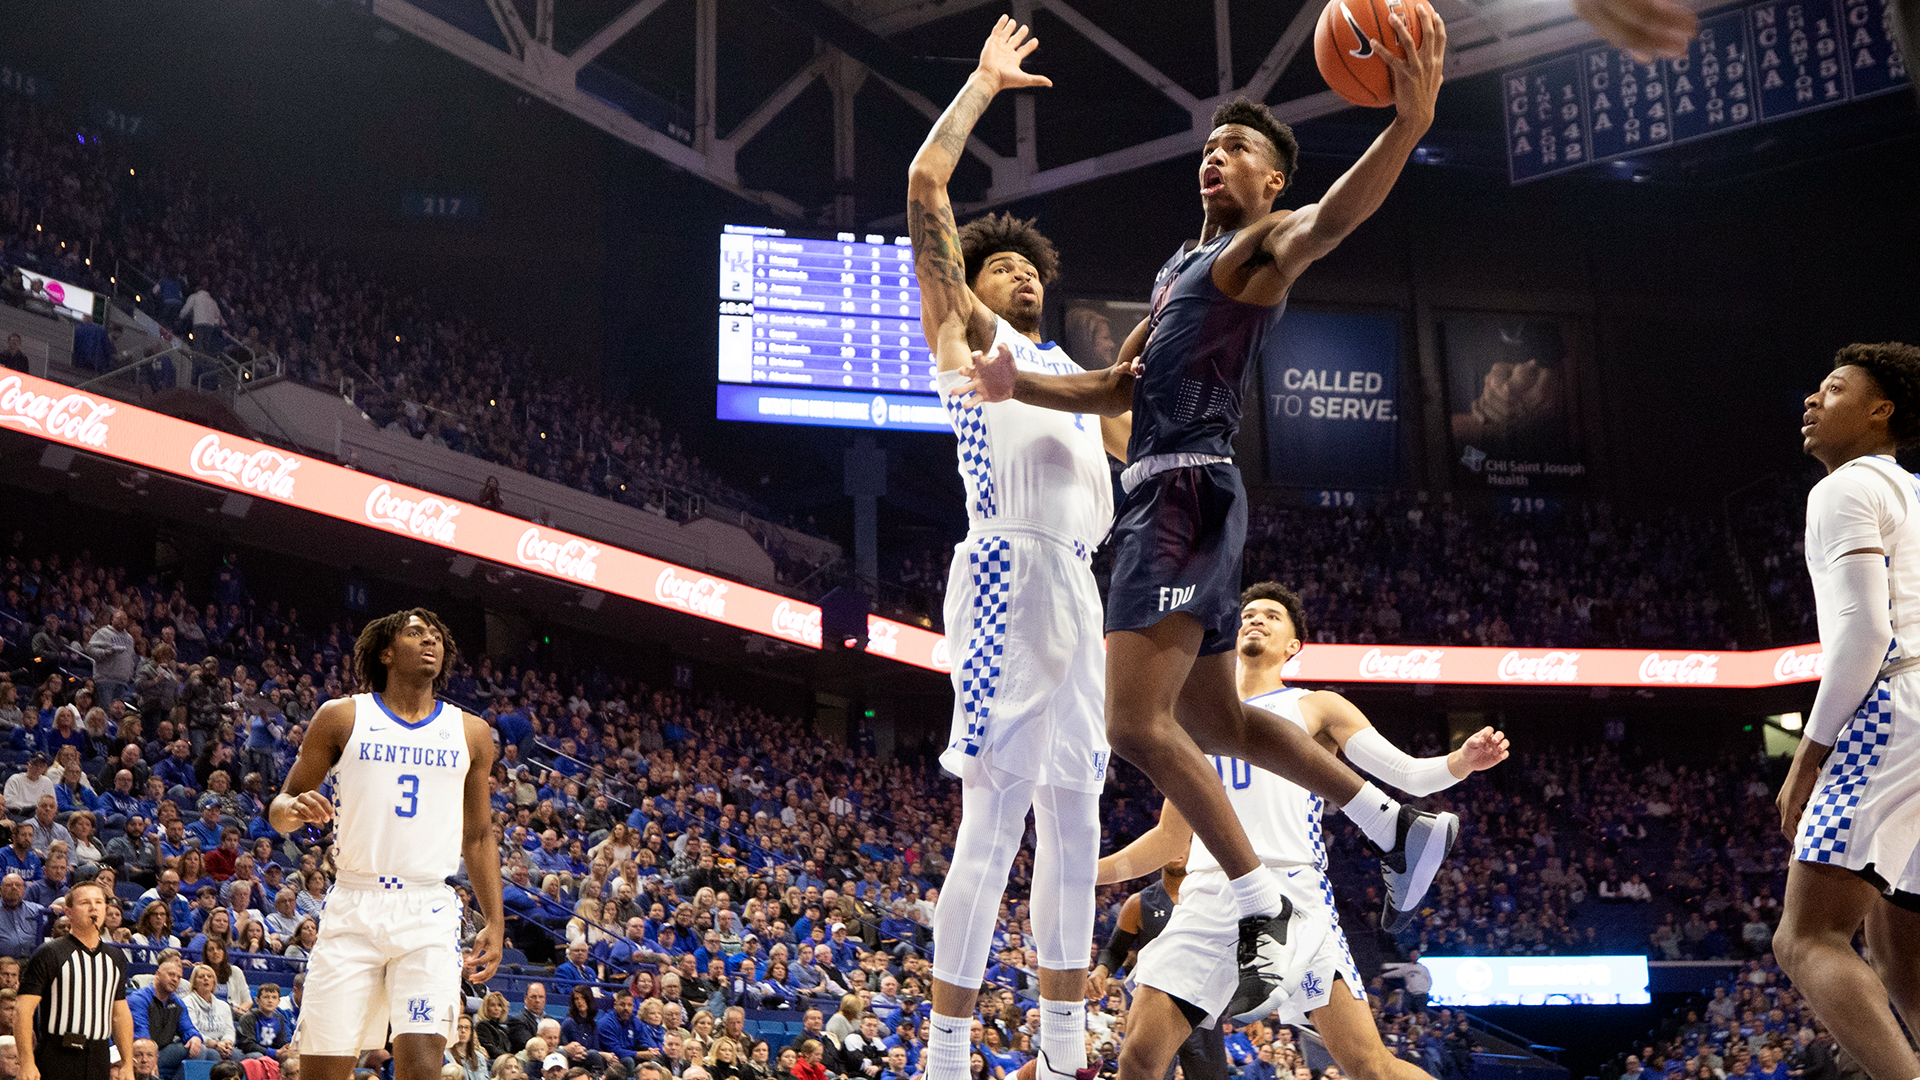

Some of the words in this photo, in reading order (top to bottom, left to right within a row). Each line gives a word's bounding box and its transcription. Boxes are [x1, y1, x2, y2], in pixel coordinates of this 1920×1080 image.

[1756, 7, 1783, 89] NCAA
[1817, 19, 1839, 100] 1951
[1591, 53, 1613, 131] NCAA
[1672, 58, 1694, 114] CAA
[1700, 28, 1724, 123] CHAMPION
[1726, 43, 1749, 121] 1949
[1509, 76, 1531, 156] NCAA
[1562, 84, 1582, 160] 1942
[731, 280, 741, 293] 2
[731, 320, 740, 333] 2
[1284, 368, 1383, 395] CALLED
[1271, 394, 1302, 417] TO
[1309, 396, 1399, 422] SERVE.
[190, 433, 301, 499] Coca-Cola
[1485, 460, 1507, 472] CHI
[1509, 460, 1541, 473] Saint
[1544, 463, 1586, 477] Joseph
[1487, 474, 1529, 486] Health
[365, 483, 462, 544] Coca-Cola
[1320, 491, 1354, 507] 219
[517, 527, 602, 583] Coca-Cola
[654, 567, 729, 618] Coca-Cola
[1158, 584, 1197, 612] FDU
[1358, 648, 1445, 680] Coca-Cola
[1498, 650, 1581, 682] Coca-Cola
[1638, 650, 1721, 685] Coca-Cola
[359, 742, 460, 768] KENTUCKY
[395, 774, 420, 818] 3
[407, 997, 435, 1023] UK
